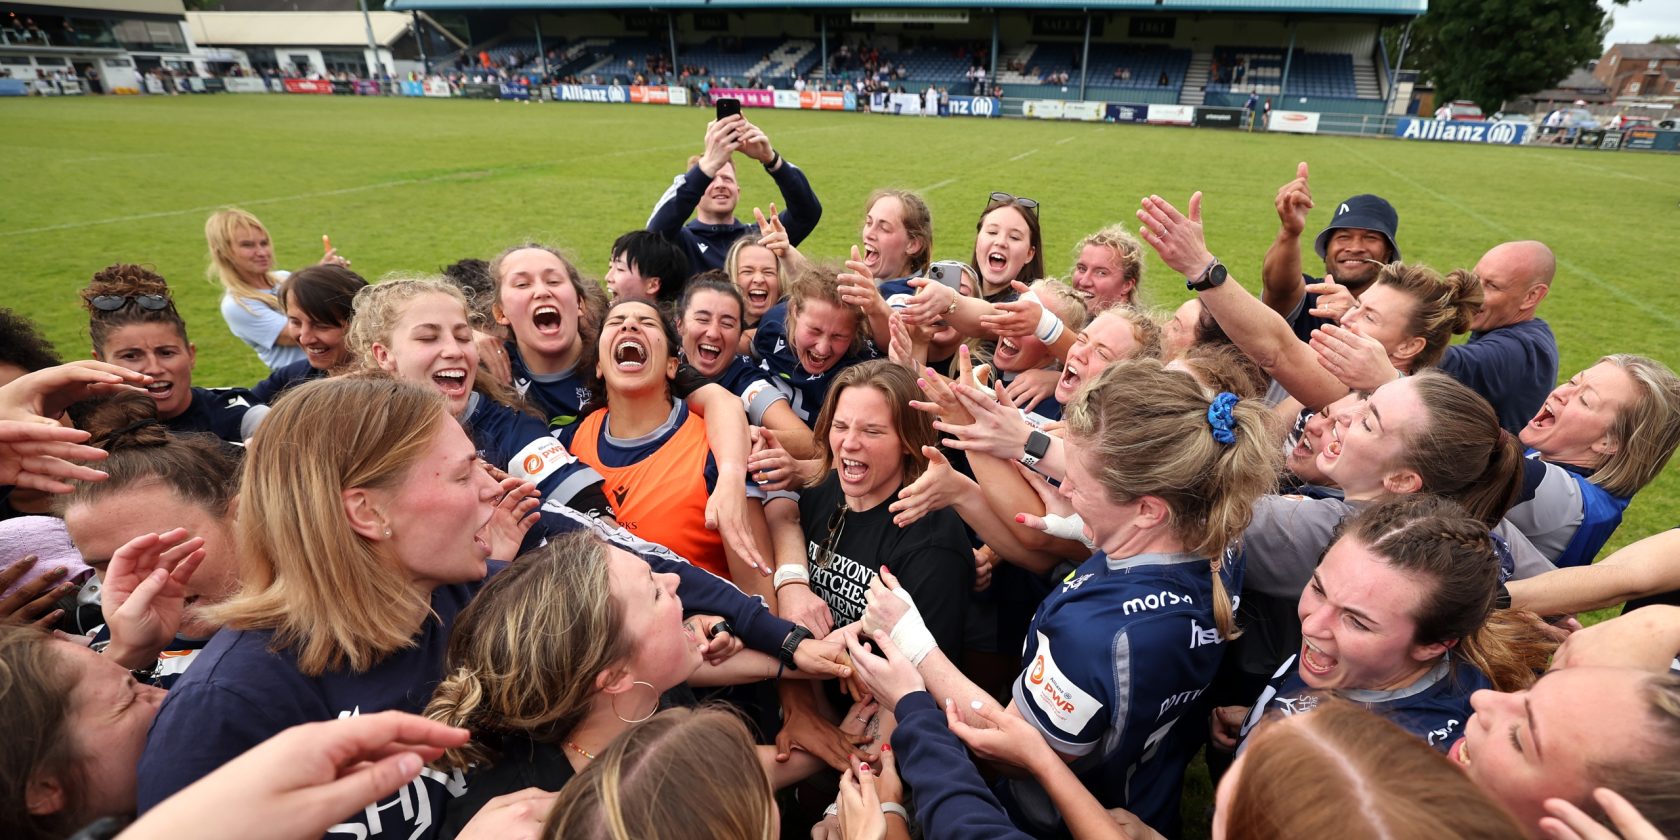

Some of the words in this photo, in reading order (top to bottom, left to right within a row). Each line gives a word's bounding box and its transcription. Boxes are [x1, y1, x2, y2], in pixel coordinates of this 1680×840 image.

[561, 84, 608, 102] Allianz
[1403, 119, 1486, 142] Allianz
[1044, 682, 1075, 714] PWR
